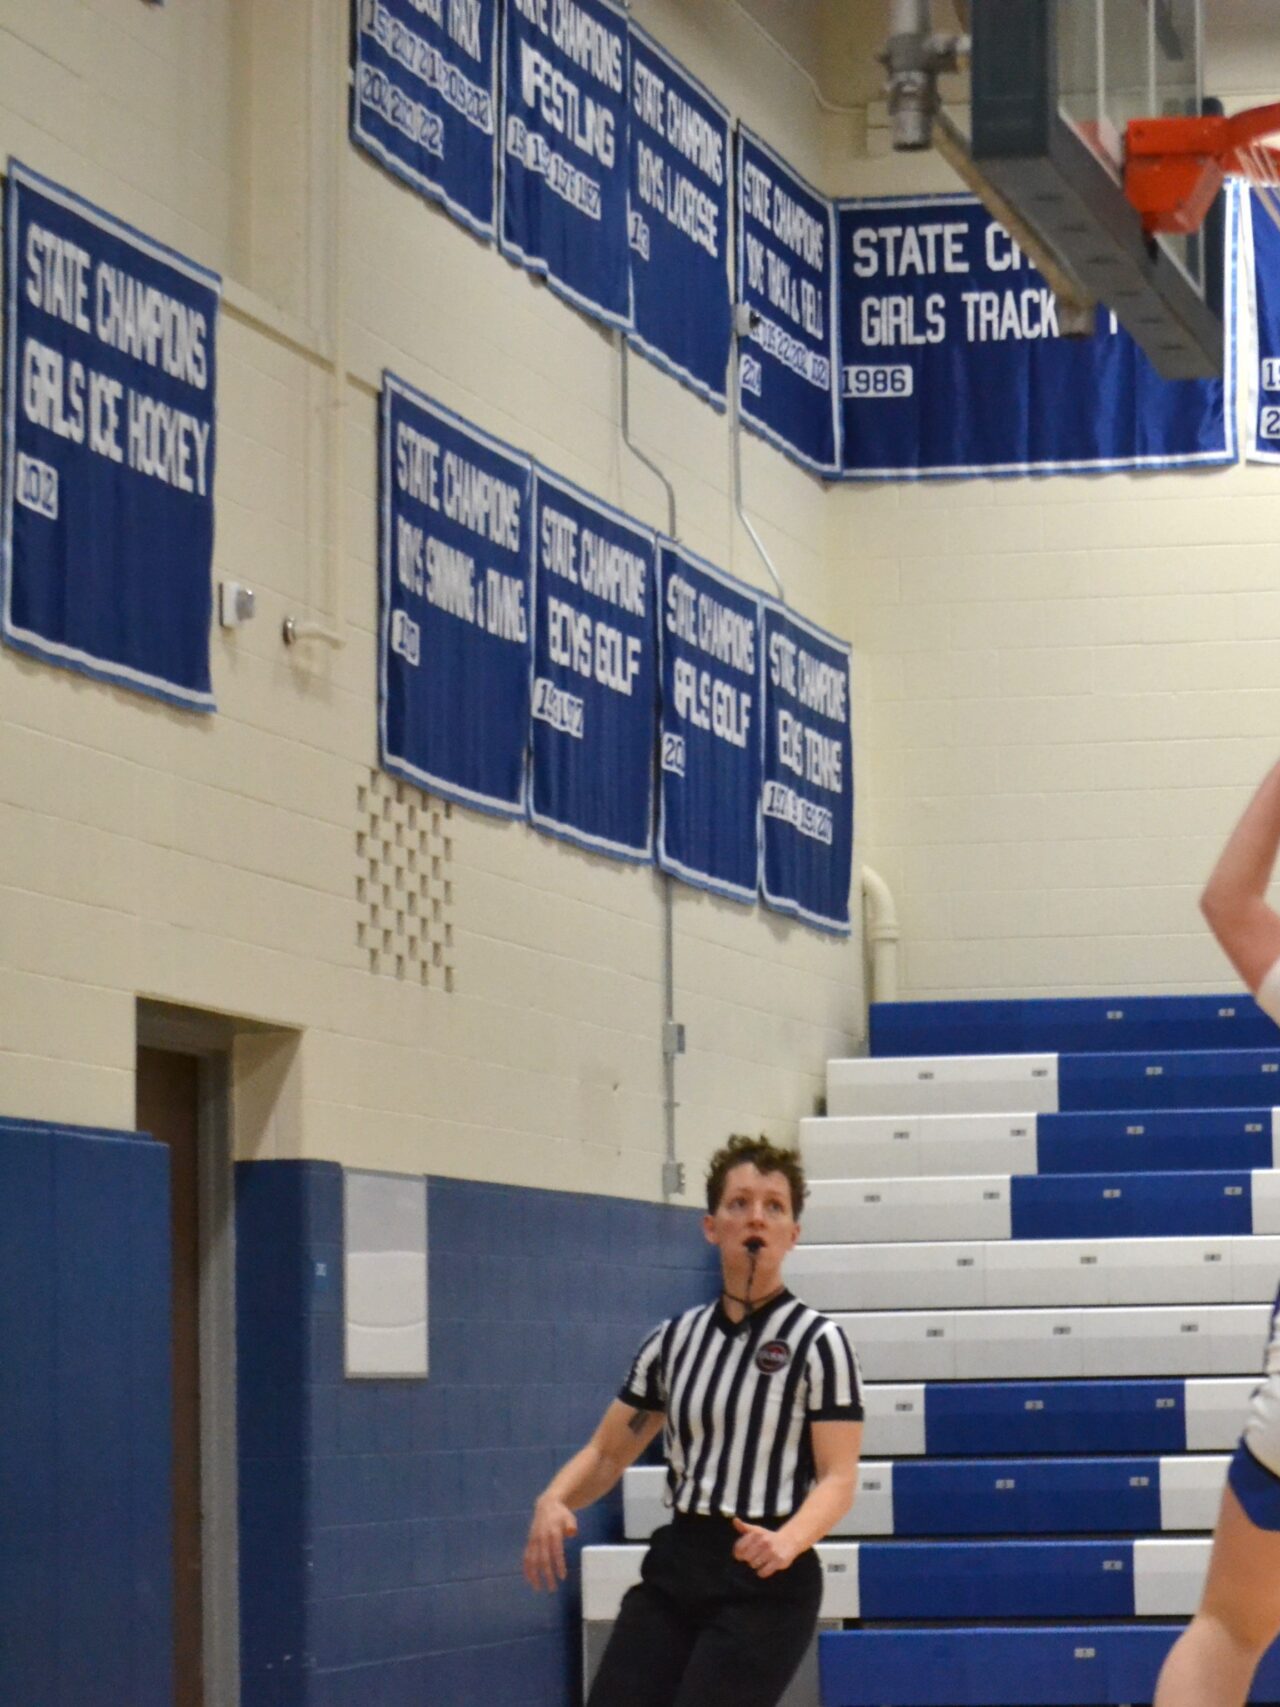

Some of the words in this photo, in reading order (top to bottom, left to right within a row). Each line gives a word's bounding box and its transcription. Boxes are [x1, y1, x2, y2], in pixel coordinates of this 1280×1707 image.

[852, 223, 969, 278] STATE
[27, 223, 91, 334] STATE
[97, 260, 208, 390] CHAMPIONS
[861, 294, 946, 347] GIRLS
[962, 288, 1060, 342] TRACK
[843, 369, 906, 395] 1986
[128, 387, 210, 497] HOCKEY
[397, 421, 440, 512] STATE
[542, 506, 578, 585] STATE
[548, 596, 592, 678] BOYS
[595, 621, 641, 697] GOLF
[713, 679, 751, 748] GOLF
